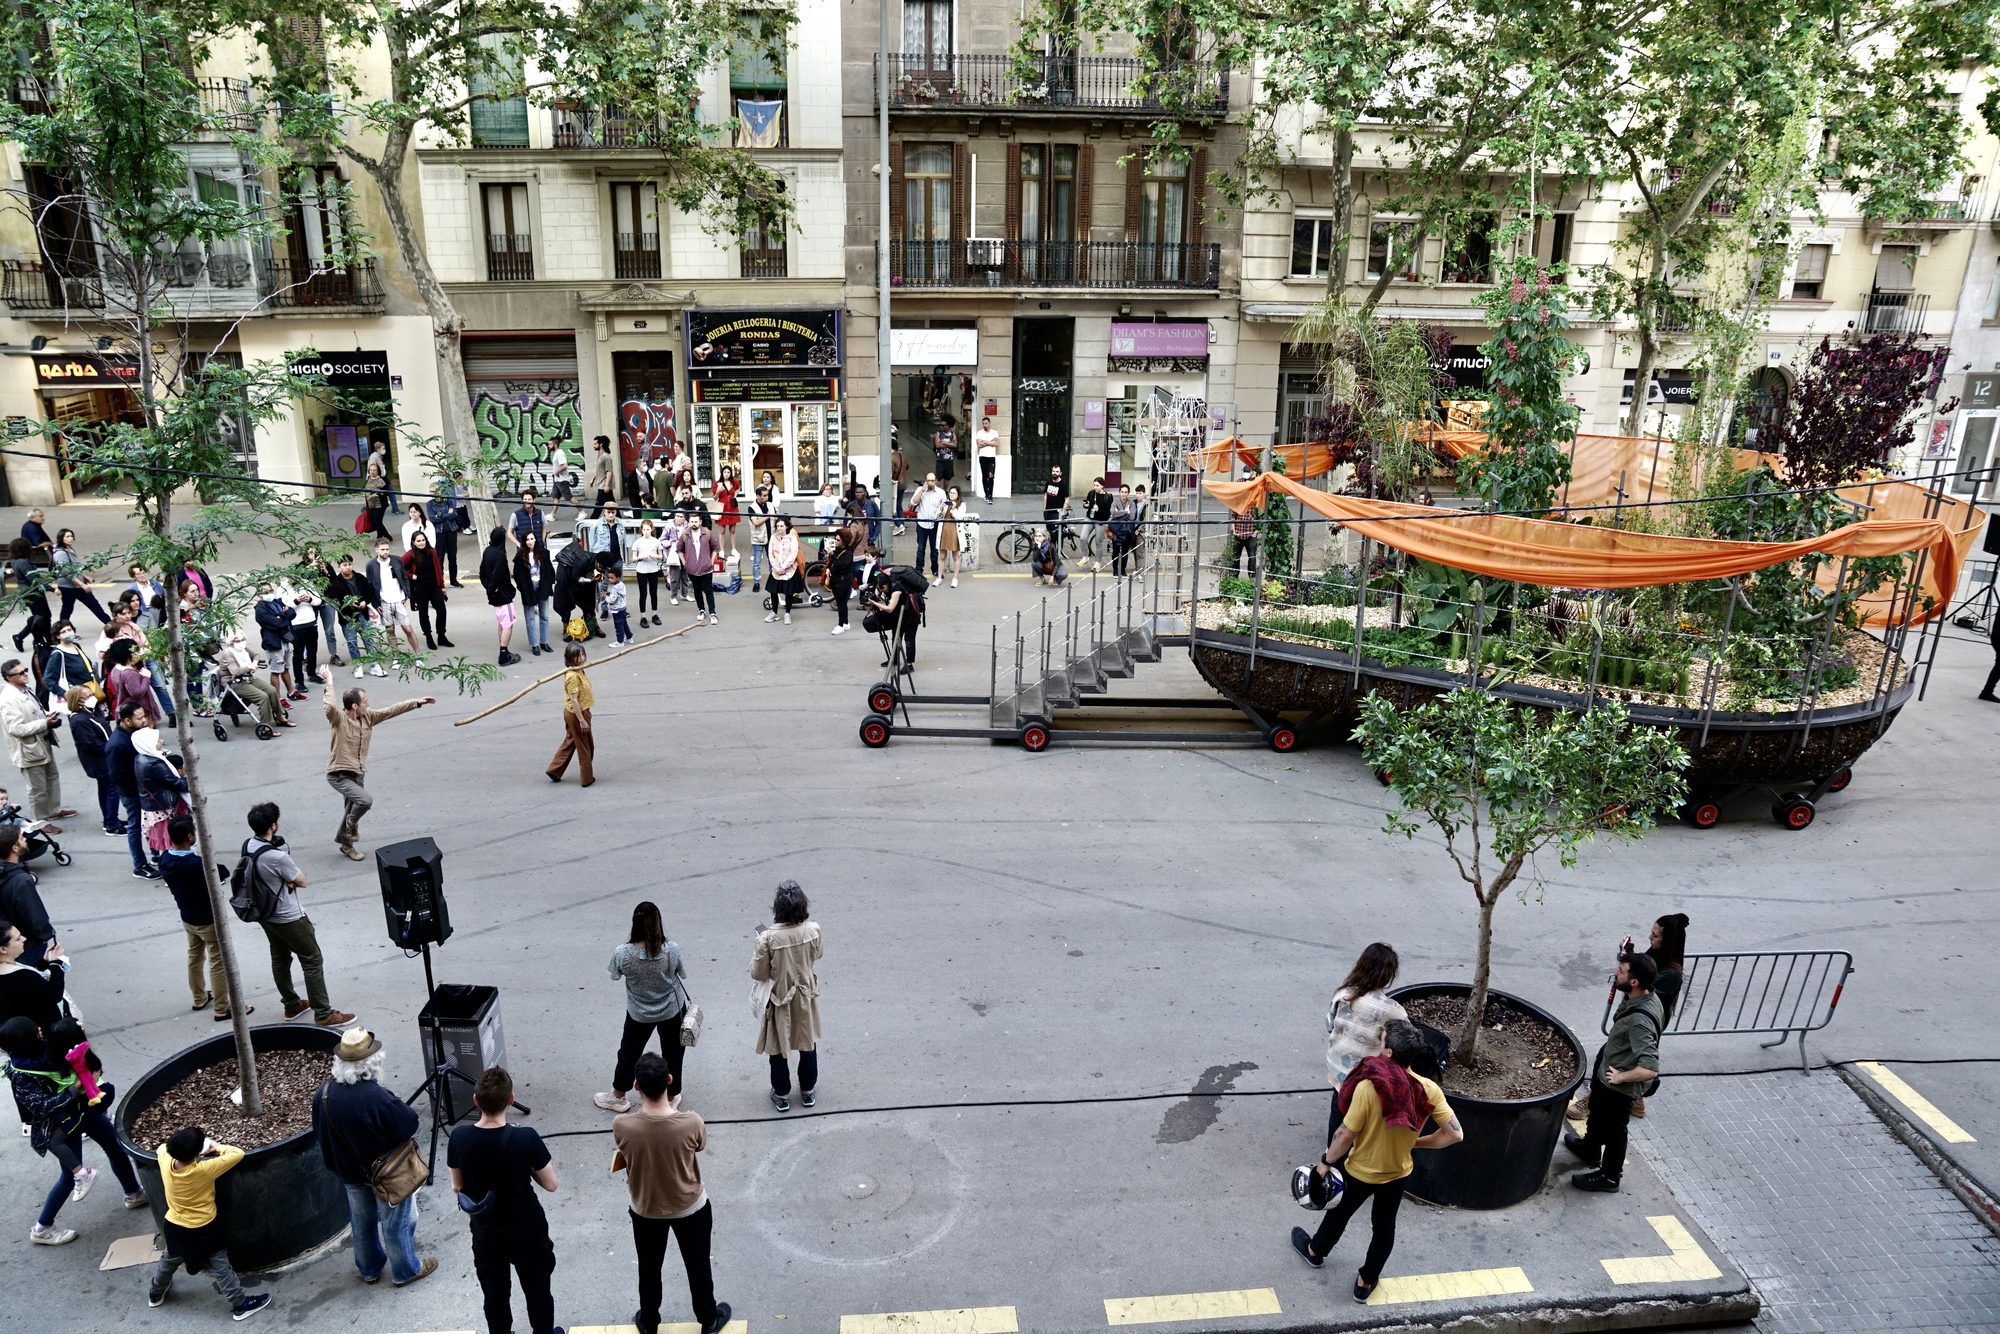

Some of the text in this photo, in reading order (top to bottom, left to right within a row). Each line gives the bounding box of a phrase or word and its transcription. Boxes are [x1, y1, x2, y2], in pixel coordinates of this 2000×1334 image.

[706, 323, 733, 342] JOIERIA
[733, 317, 776, 330] RELLOGERIA
[782, 320, 818, 342] BISUTERIA
[740, 331, 780, 339] RONDAS
[1158, 328, 1206, 338] FASHION
[1044, 344, 1053, 352] 18
[1453, 355, 1493, 369] much
[288, 364, 385, 375] HIGH SOCIETY
[1975, 380, 1992, 396] 12
